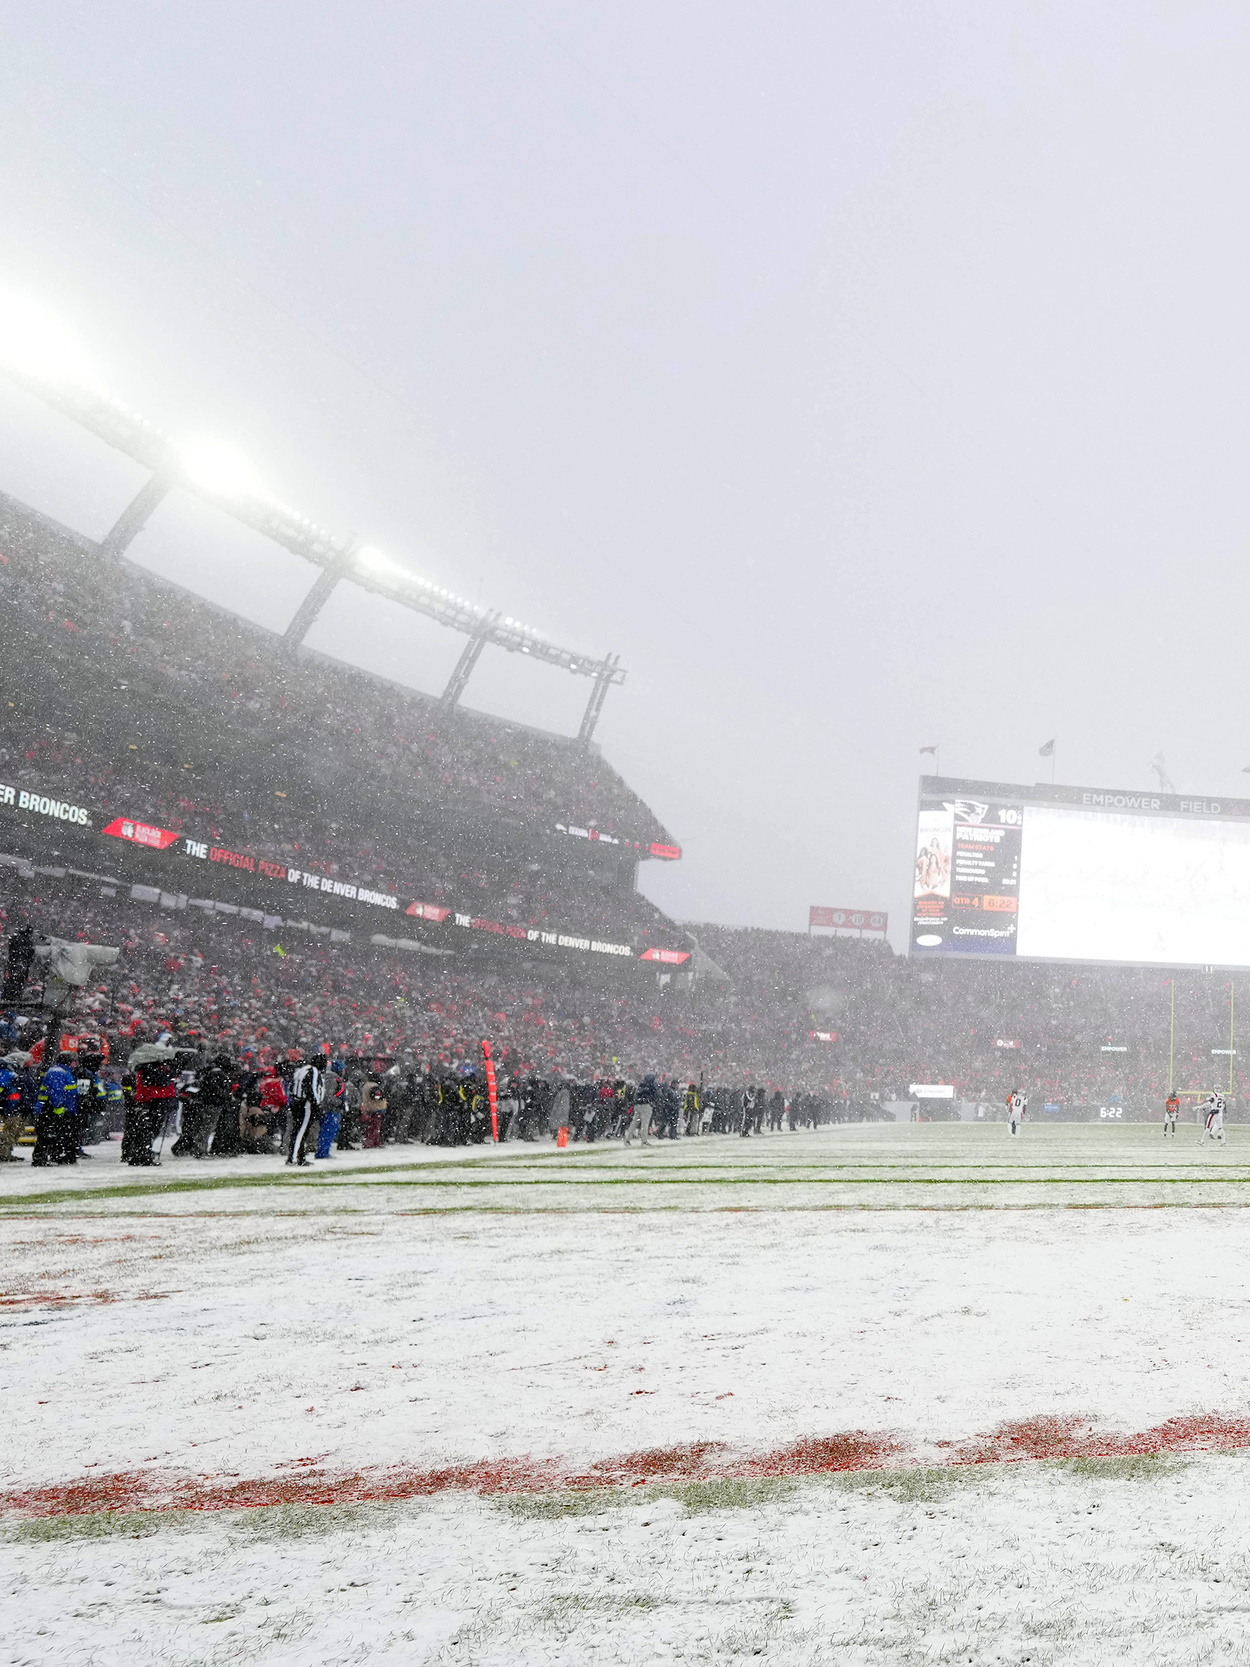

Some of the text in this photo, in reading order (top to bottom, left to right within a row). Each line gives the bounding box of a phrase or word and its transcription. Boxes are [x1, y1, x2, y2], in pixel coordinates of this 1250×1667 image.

[1082, 793, 1220, 814] EMPOWER FIELD
[998, 809, 1017, 824] 10
[956, 833, 1000, 843] PATRIOTS
[185, 839, 209, 859] THE
[209, 847, 255, 871] OFFICIAL
[258, 861, 286, 880] PIZZA
[288, 869, 300, 883] OF
[303, 872, 320, 889] THE
[321, 878, 357, 899] DENVER
[972, 897, 979, 907] 4
[988, 899, 1012, 908] 6:22
[455, 913, 471, 928] THE
[527, 929, 538, 941] OF
[541, 931, 557, 945] THE
[558, 935, 590, 950] DENVER
[953, 926, 1010, 938] CommonSpirit
[1015, 1099, 1021, 1107] 0
[1100, 1107, 1122, 1118] 6:22
